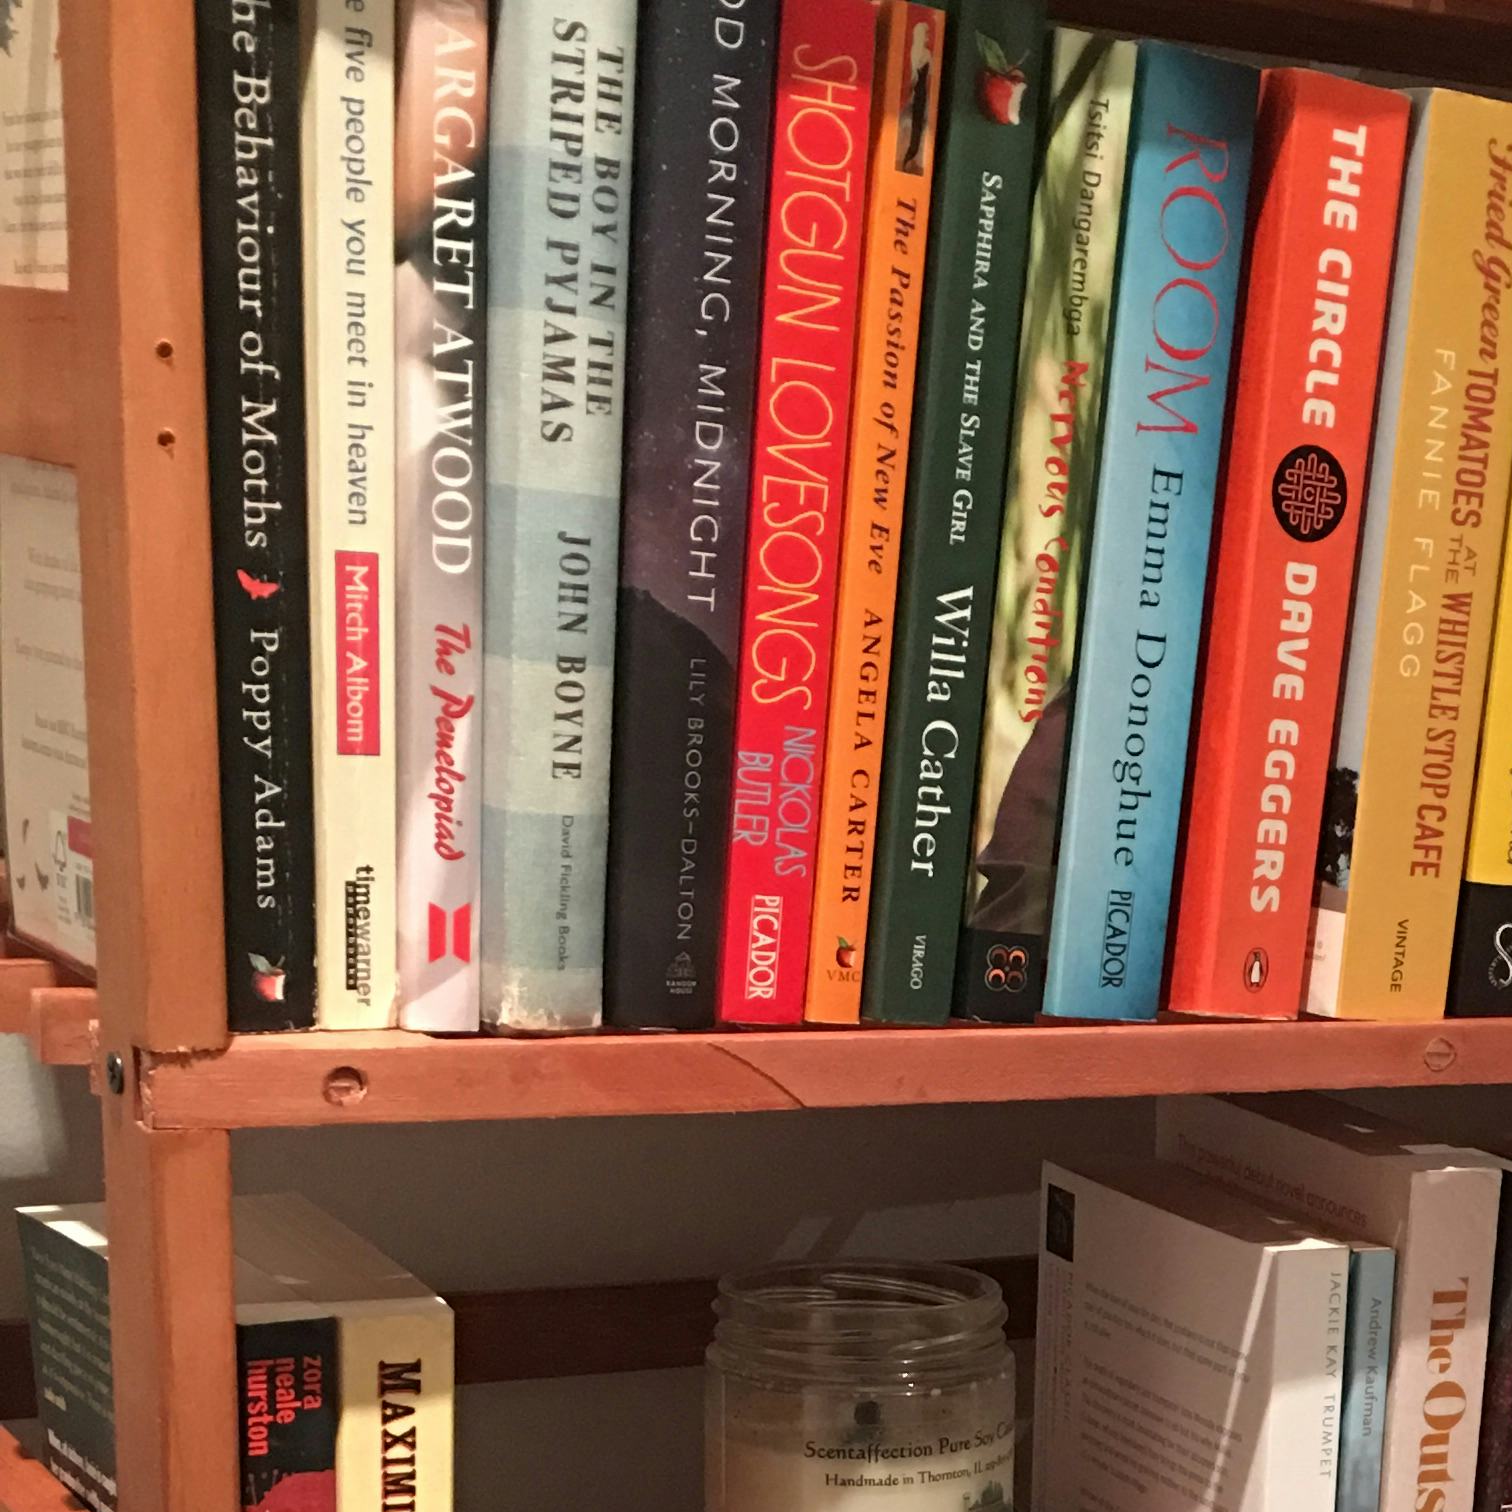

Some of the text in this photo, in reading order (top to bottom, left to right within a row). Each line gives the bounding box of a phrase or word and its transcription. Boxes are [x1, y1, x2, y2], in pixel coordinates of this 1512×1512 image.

[539, 17, 589, 444] STRIPED PYJAMAS
[585, 46, 625, 417] THE BOY IN THE
[1066, 98, 1109, 337] Tsitsi Dangarembga
[1301, 124, 1367, 429] THE CIRCLE
[234, 75, 283, 548] Behaviour of Moths
[1112, 123, 1228, 866] ROOM Emma Donoghue
[242, 629, 285, 908] Poppy Adams
[911, 586, 973, 878] Willa Cather
[557, 815, 574, 971] David Fickling Books
[909, 935, 927, 989] VIRAGO
[1101, 889, 1134, 989] PICADOR
[1390, 919, 1409, 993] VINTAGE
[247, 1360, 268, 1456] hurston
[274, 1357, 295, 1425] neale
[304, 1355, 322, 1410] zora
[803, 1442, 933, 1462] Scentaffection
[939, 1437, 971, 1453] Pure
[825, 1474, 899, 1487] Handmade
[903, 1475, 914, 1485] in
